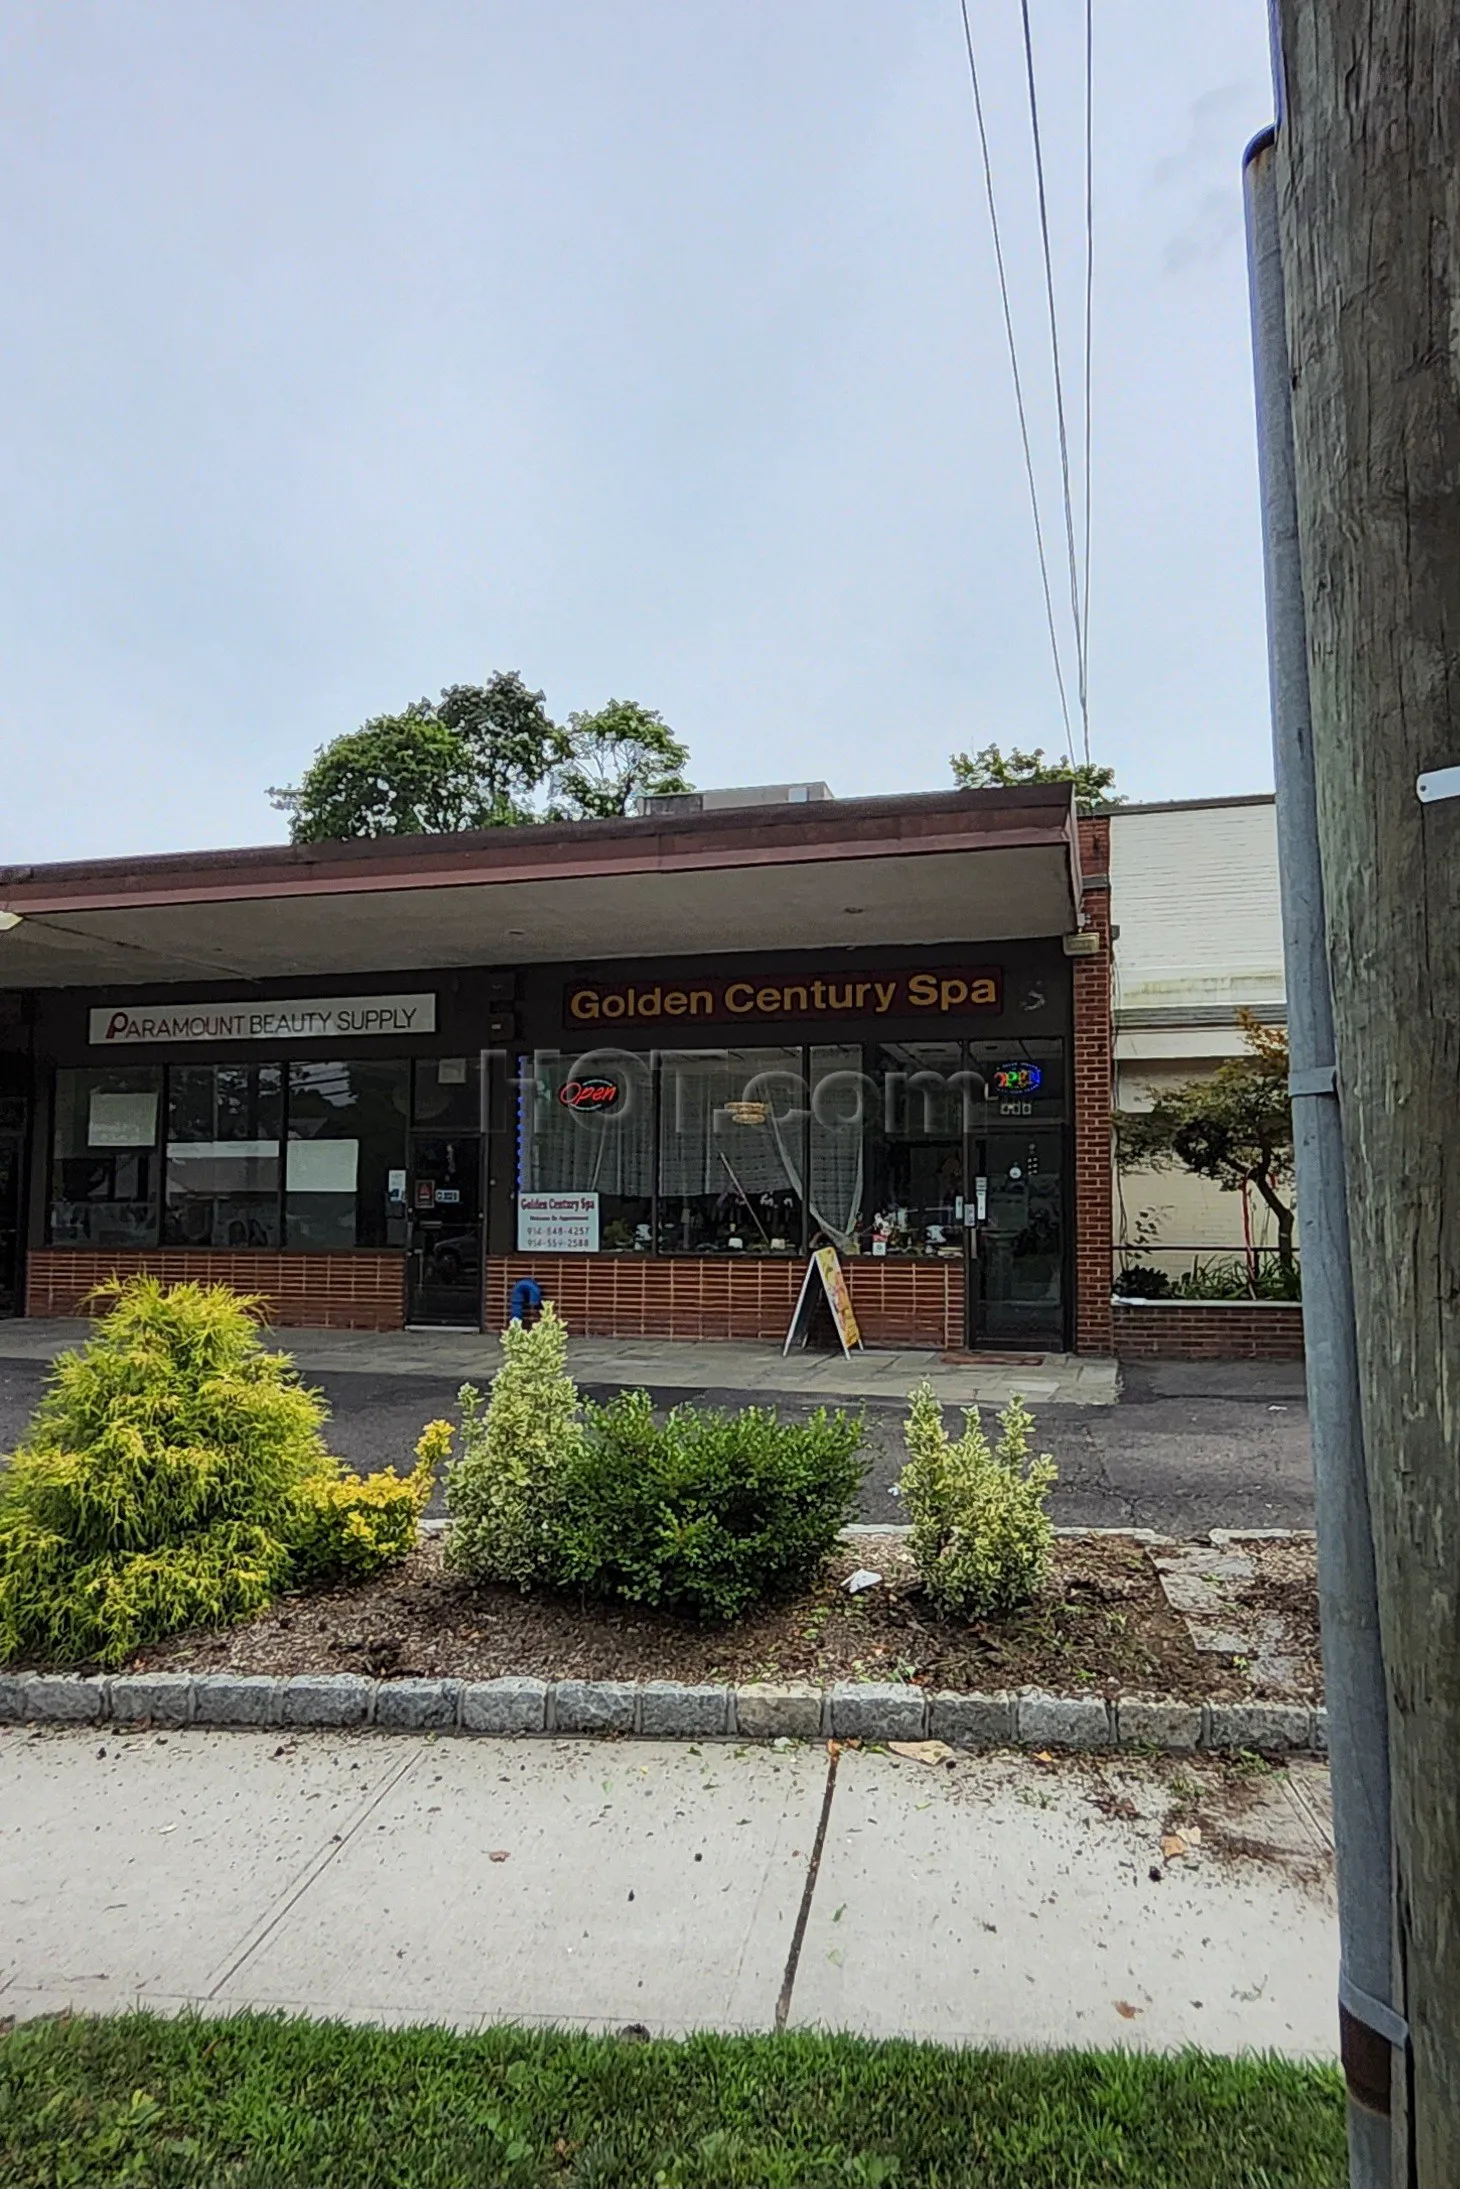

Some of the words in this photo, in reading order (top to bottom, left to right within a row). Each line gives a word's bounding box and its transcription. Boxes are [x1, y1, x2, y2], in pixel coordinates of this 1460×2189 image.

[570, 986, 714, 1020] Golden
[724, 980, 897, 1013] Century
[907, 974, 997, 1011] Spa
[105, 1011, 246, 1040] PARAMOUNT
[250, 1011, 332, 1035] BEAUTY
[337, 1007, 418, 1031] SUPPLY
[560, 1082, 617, 1106] Open
[549, 1198, 579, 1212] Century
[581, 1197, 595, 1212] Spa
